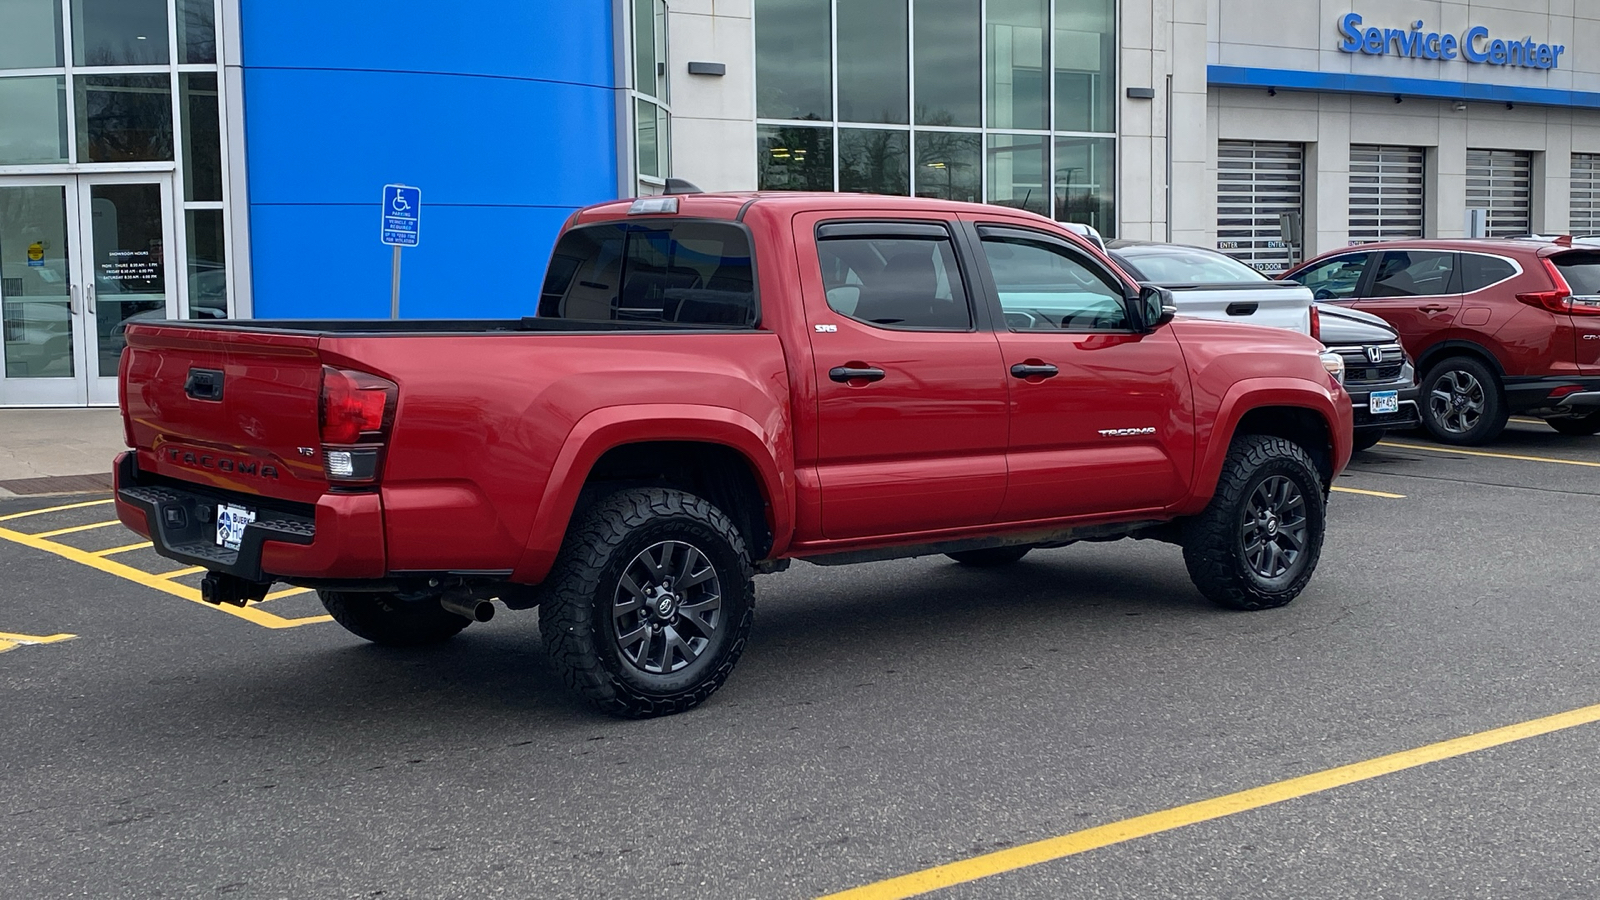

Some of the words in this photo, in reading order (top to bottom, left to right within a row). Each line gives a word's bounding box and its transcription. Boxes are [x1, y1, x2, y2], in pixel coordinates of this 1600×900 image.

[1338, 13, 1457, 60] Service
[1461, 26, 1565, 69] Center
[1220, 241, 1238, 249] ENTER
[814, 324, 838, 333] SR5
[1098, 427, 1156, 437] TACOMA
[297, 446, 315, 457] V6
[168, 448, 279, 480] TACOMA
